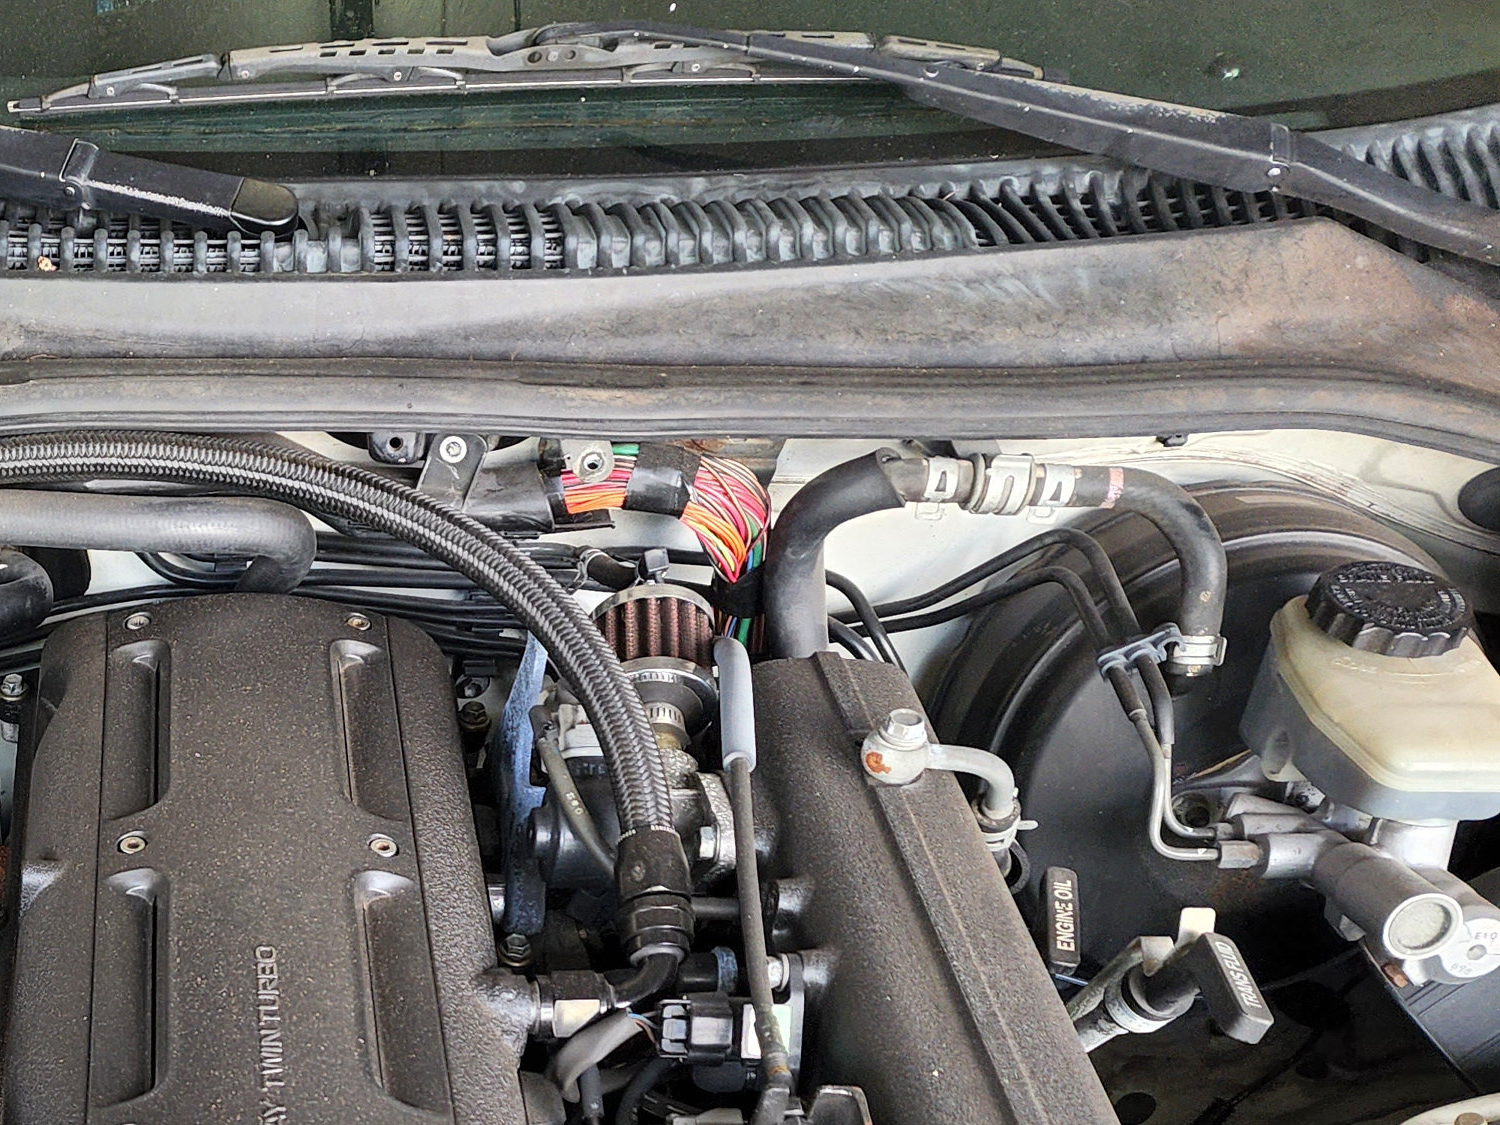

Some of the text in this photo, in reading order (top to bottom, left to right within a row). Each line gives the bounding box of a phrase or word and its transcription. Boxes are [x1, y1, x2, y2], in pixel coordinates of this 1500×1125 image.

[1052, 878, 1077, 952] ENGINE OIL
[254, 944, 281, 1026] TURBO
[1213, 937, 1262, 1008] TRANS FLUID
[258, 1028, 285, 1092] TWIN
